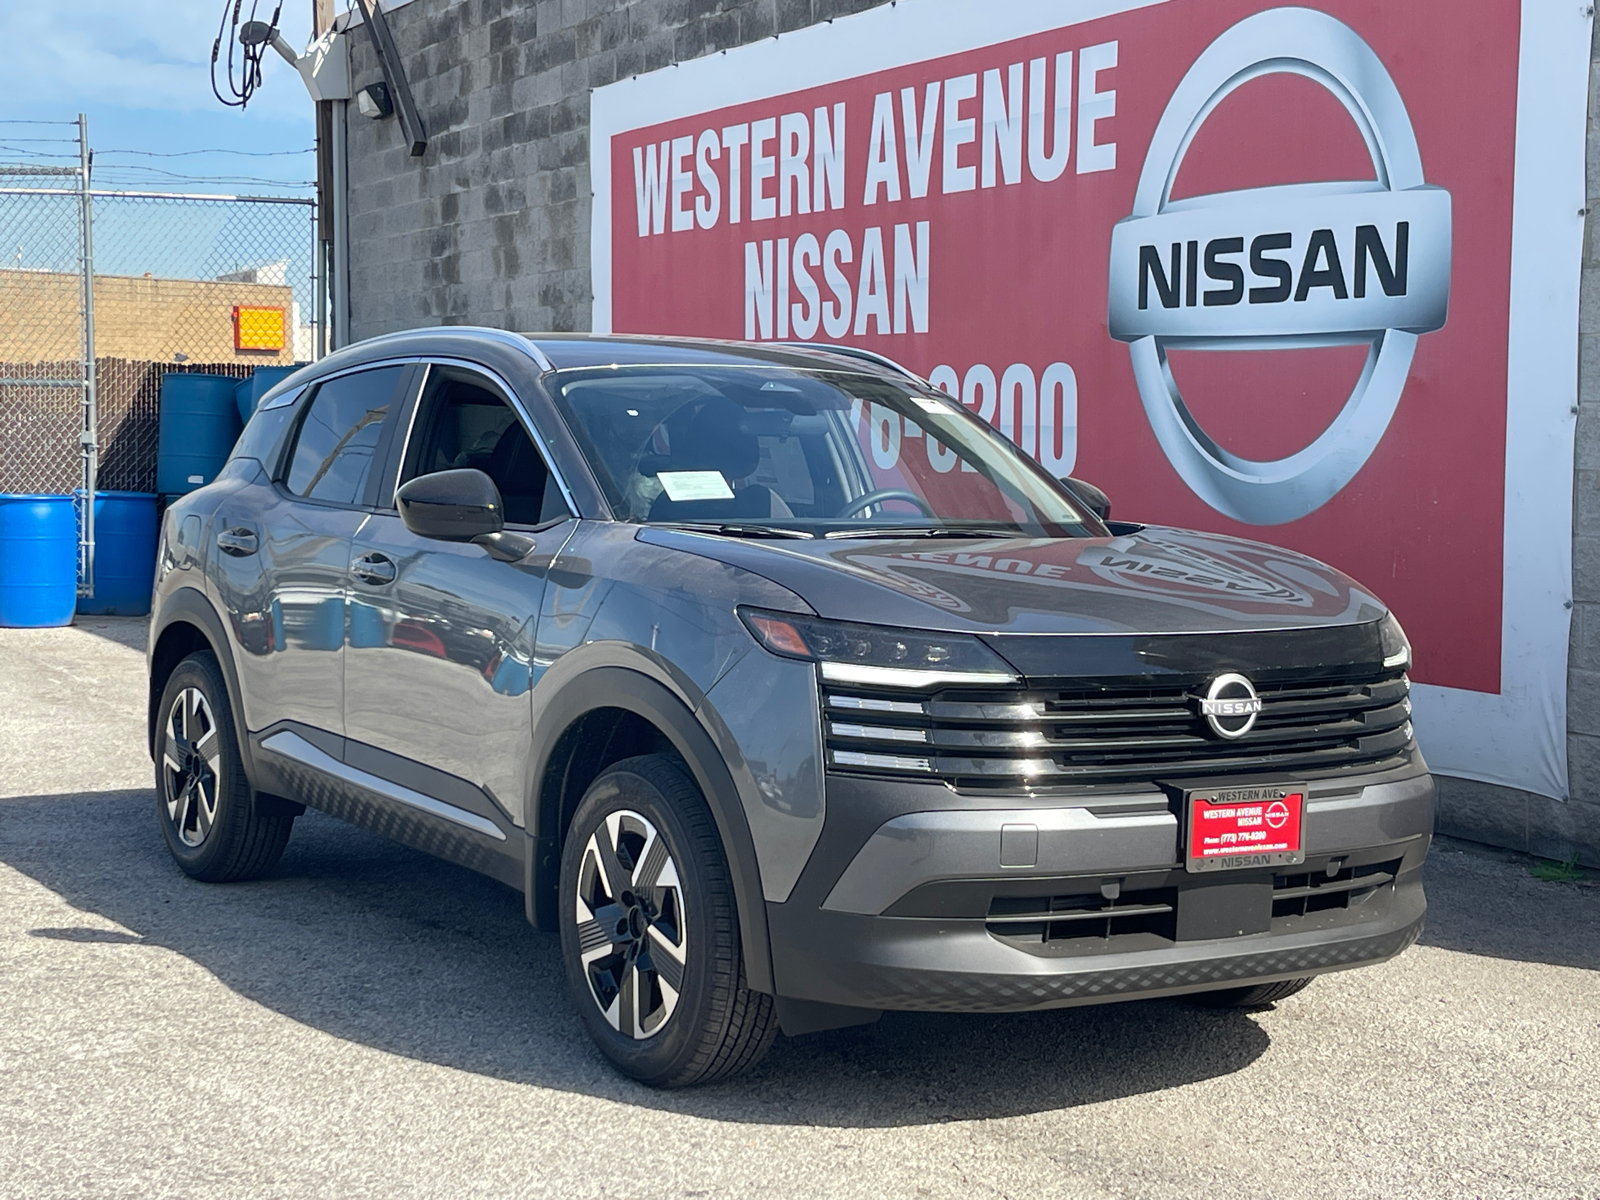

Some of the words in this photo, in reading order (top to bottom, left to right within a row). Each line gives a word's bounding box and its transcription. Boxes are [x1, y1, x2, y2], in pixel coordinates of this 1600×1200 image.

[633, 102, 846, 238] WESTERN
[863, 40, 1119, 206] AVENUE
[1138, 221, 1410, 310] NISSAN
[744, 220, 930, 341] NISSAN
[1204, 700, 1261, 714] NISSAN
[1218, 789, 1259, 802] WESTERN
[1262, 789, 1279, 800] AVE
[1203, 808, 1236, 820] WESTERN
[1236, 806, 1263, 818] AVENUE
[1237, 816, 1262, 827] NISSAN
[1221, 855, 1271, 868] NISSAN
